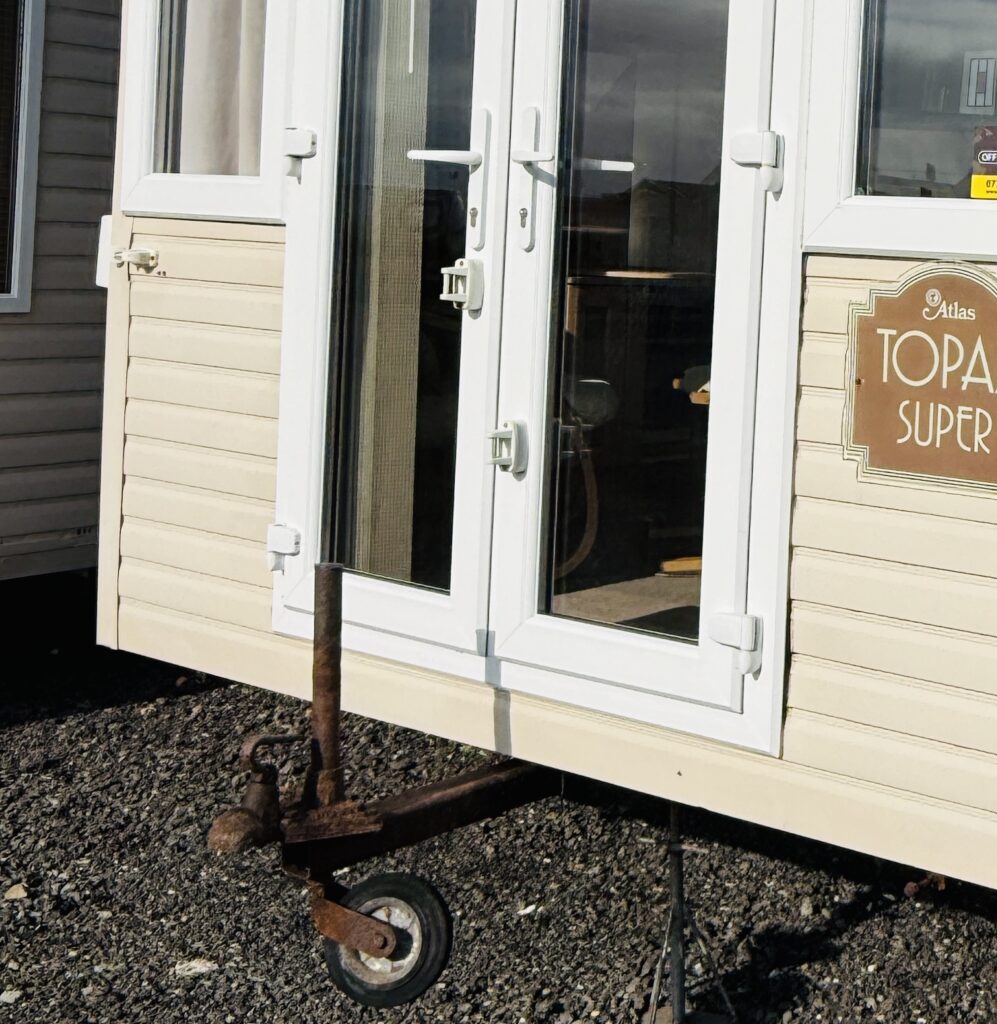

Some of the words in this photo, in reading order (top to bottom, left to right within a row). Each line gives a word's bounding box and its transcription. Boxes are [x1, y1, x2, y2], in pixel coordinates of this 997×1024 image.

[981, 153, 997, 161] OFF
[922, 299, 976, 321] Atlas
[896, 399, 993, 454] SUPER
